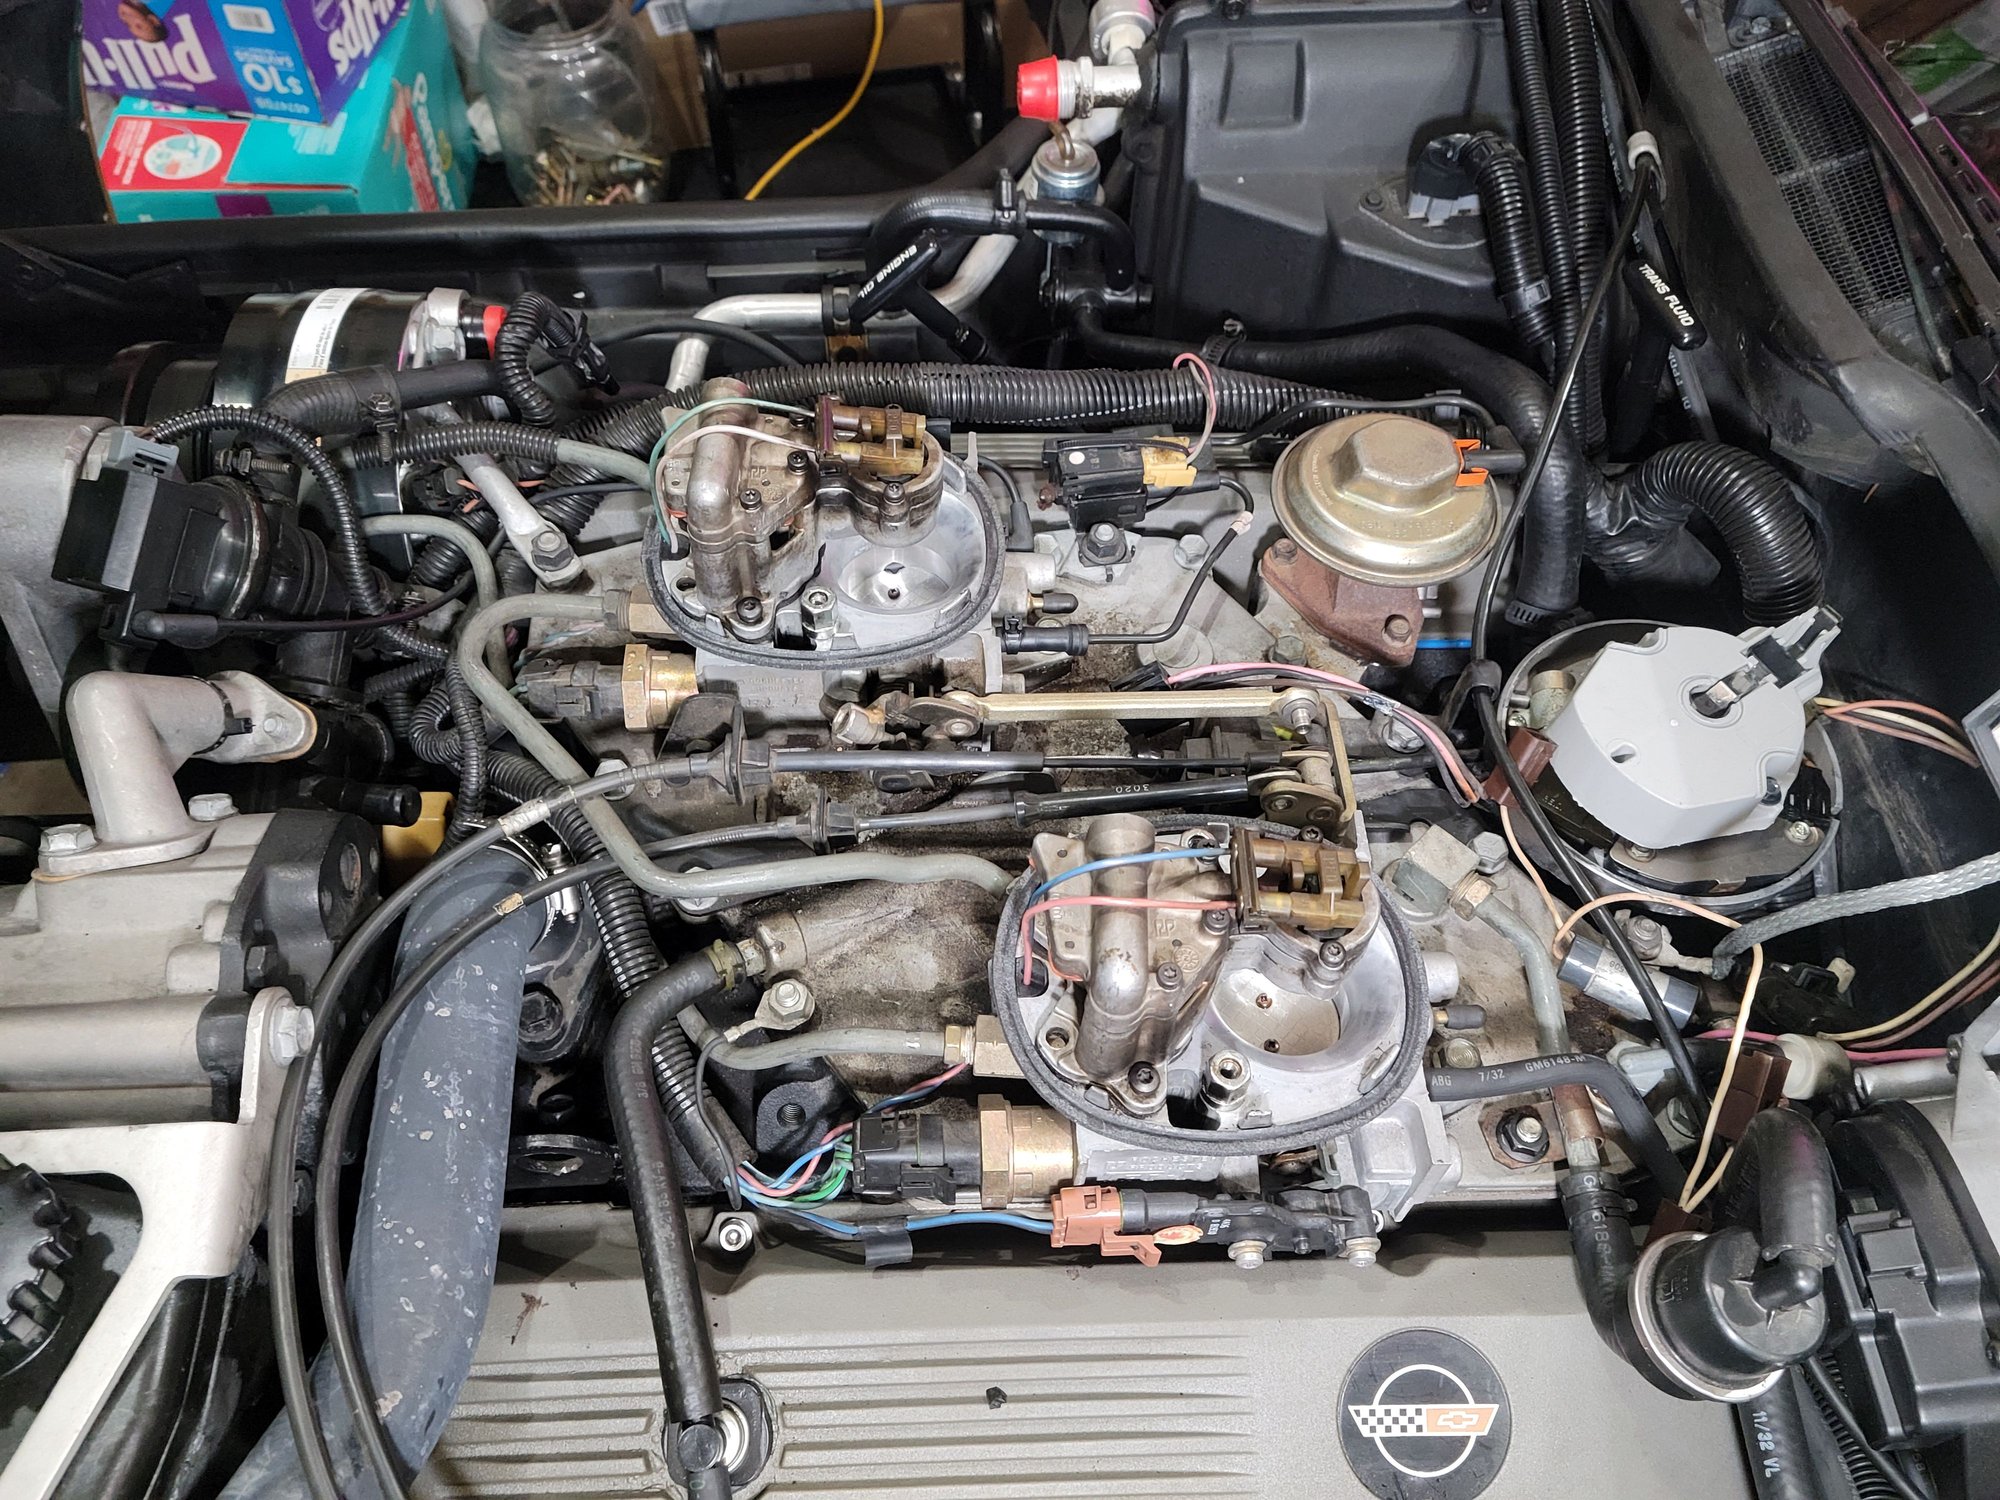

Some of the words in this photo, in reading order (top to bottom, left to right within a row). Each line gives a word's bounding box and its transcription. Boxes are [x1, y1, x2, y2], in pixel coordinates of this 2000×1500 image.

[243, 63, 304, 96] $10
[876, 244, 918, 283] ENGINE
[857, 281, 875, 299] OIL
[1638, 263, 1671, 295] TRANS
[1664, 294, 1695, 327] FLUID
[1115, 784, 1149, 794] 3020
[1478, 1068, 1506, 1083] 7/32
[1752, 1411, 1775, 1451] 11/32
[1763, 1457, 1781, 1478] VL
